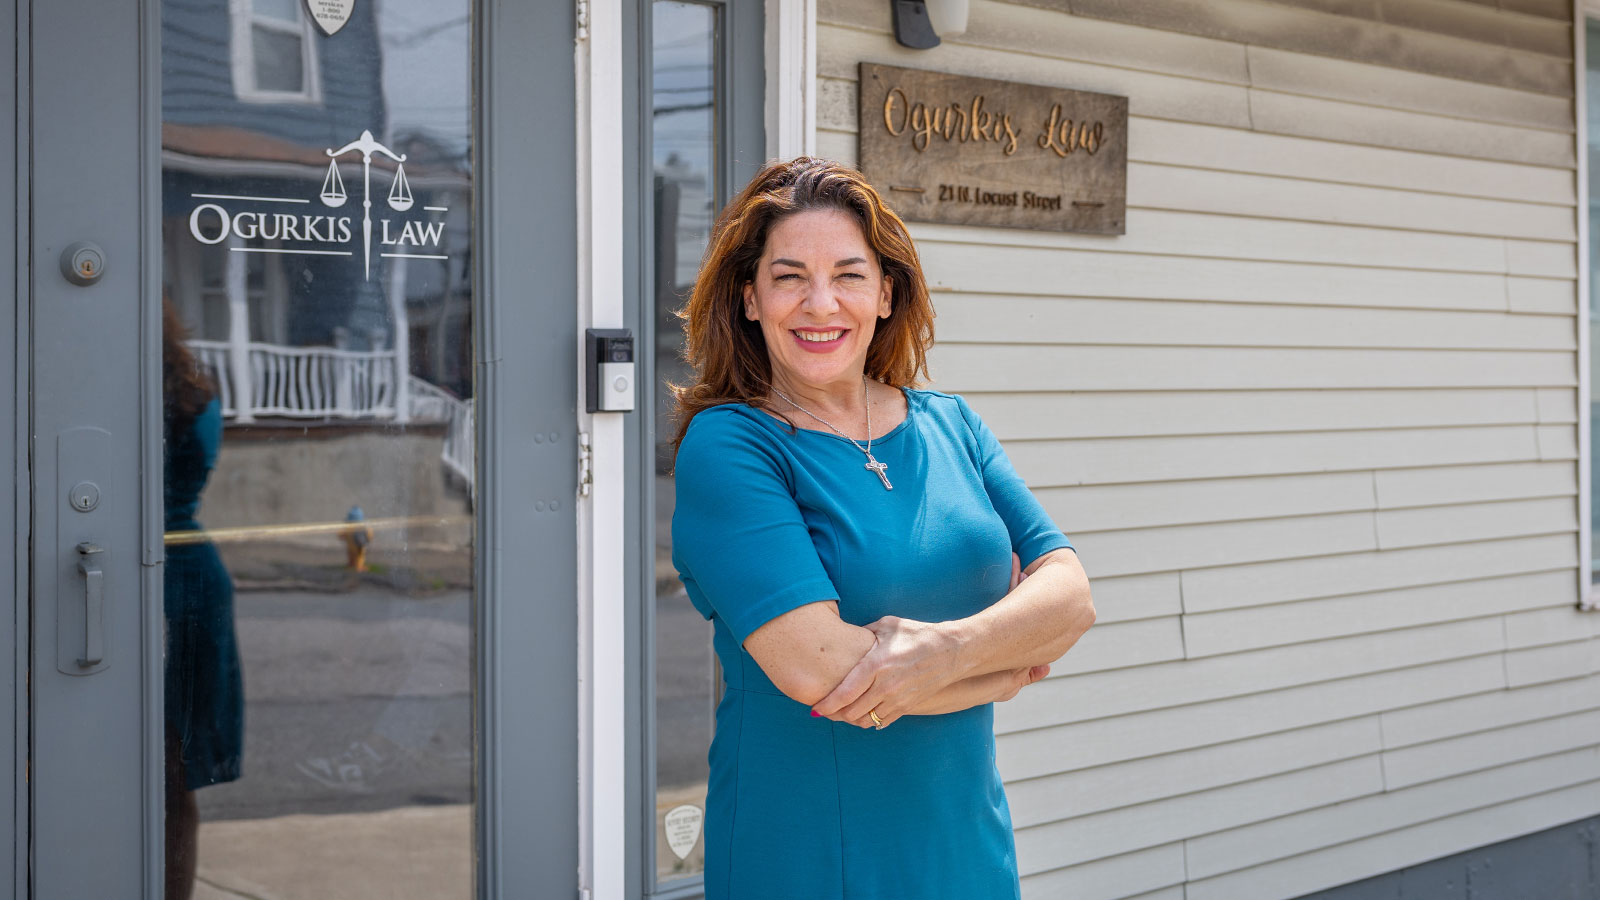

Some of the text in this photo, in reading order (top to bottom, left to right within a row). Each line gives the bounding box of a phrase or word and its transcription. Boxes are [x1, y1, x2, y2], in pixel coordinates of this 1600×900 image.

[883, 87, 1107, 158] Ogurkis Law
[938, 183, 1062, 211] 21 N. Locust Street
[189, 203, 445, 247] OGURKIS LAW
